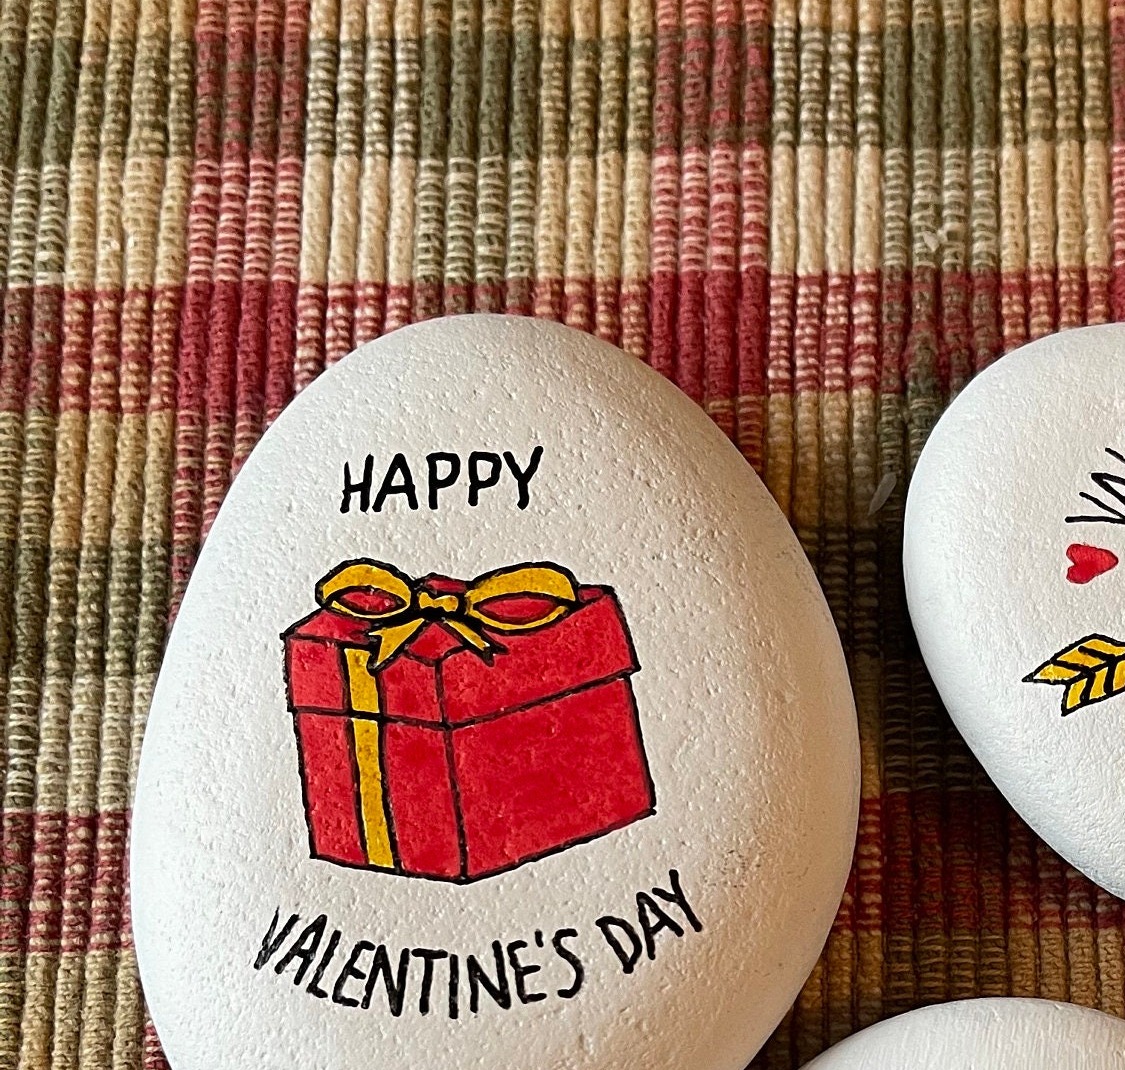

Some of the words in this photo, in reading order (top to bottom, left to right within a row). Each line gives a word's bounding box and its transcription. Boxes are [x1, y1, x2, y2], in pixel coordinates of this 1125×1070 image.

[339, 445, 544, 514] HAPPY
[253, 905, 586, 1020] VALENTINE'S
[594, 868, 703, 976] DAY
